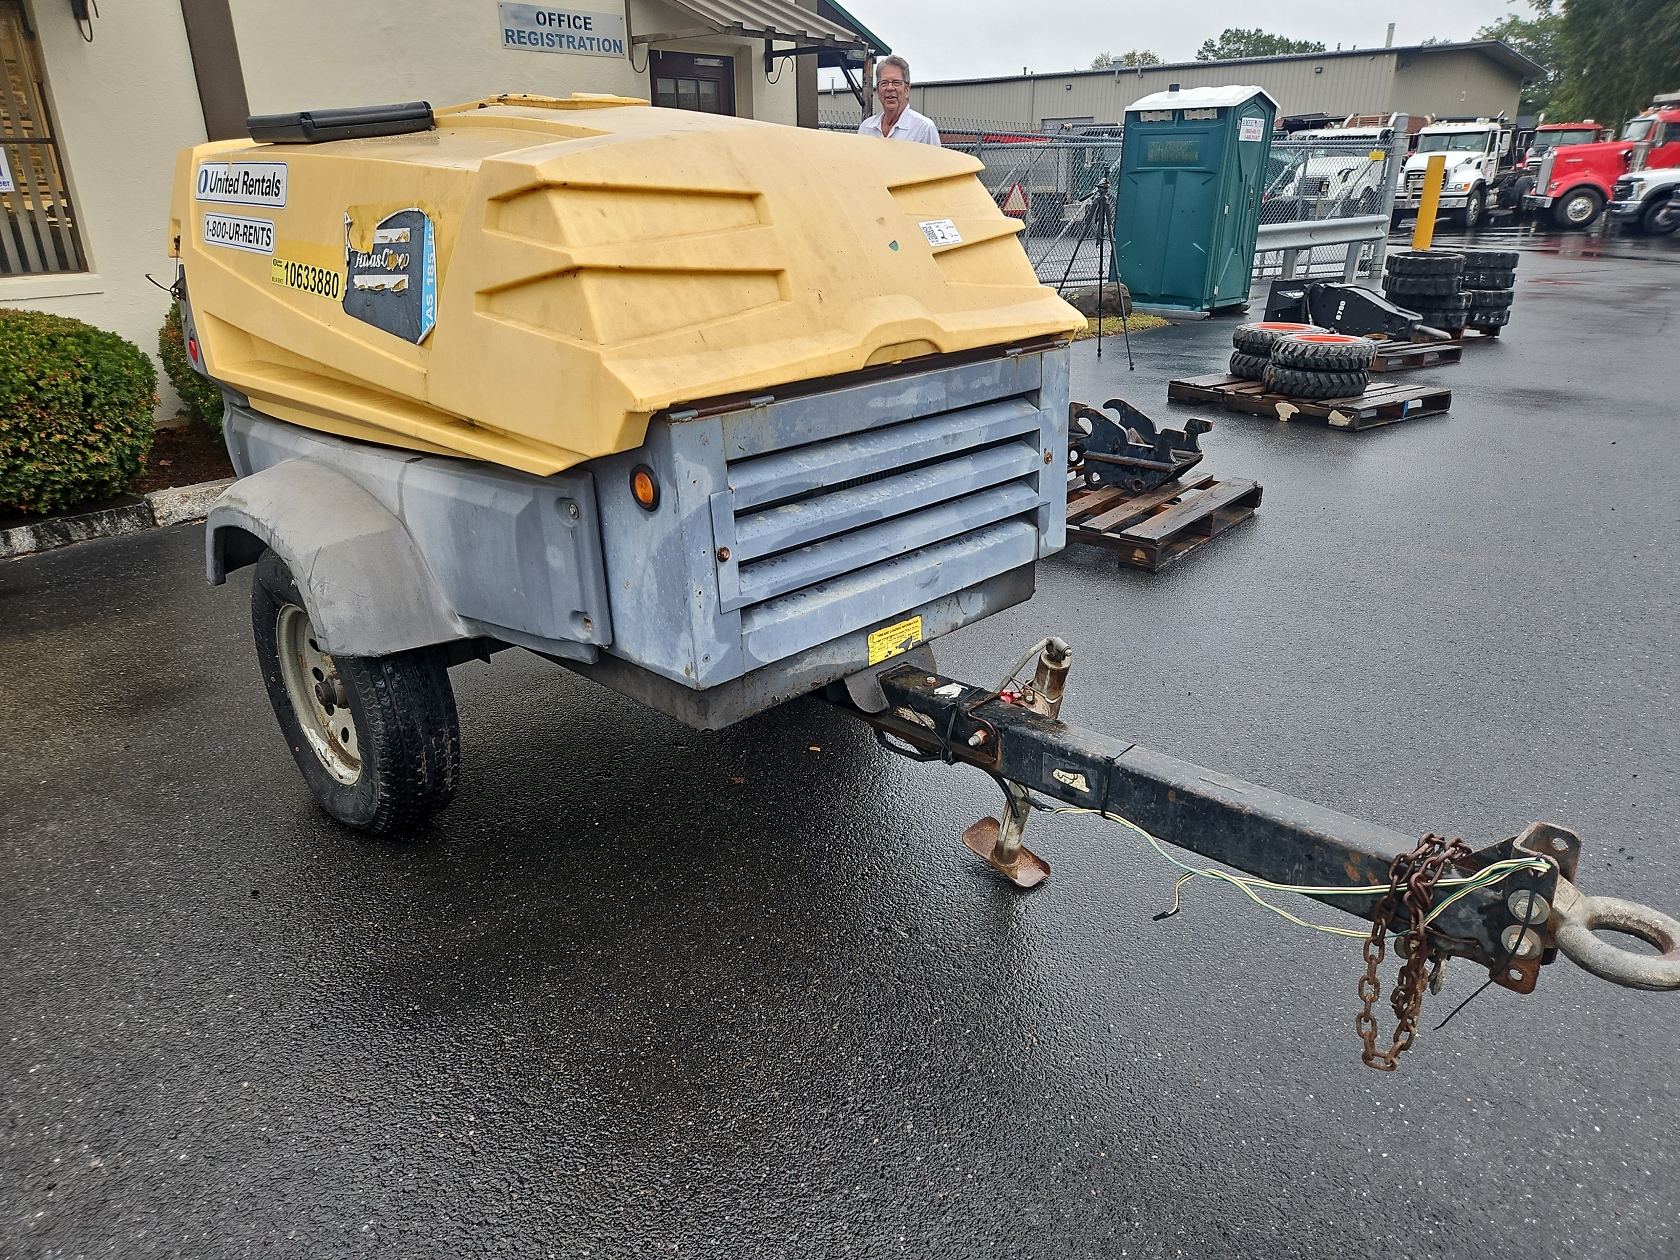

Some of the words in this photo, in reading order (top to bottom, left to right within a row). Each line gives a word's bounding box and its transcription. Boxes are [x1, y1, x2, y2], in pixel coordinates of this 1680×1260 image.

[536, 10, 593, 31] OFFICE
[504, 28, 623, 54] REGISTRATION
[209, 170, 241, 195] United
[241, 170, 281, 197] Rentals
[206, 220, 272, 247] 1-800-UR-RENTS
[284, 261, 339, 299] 10633880
